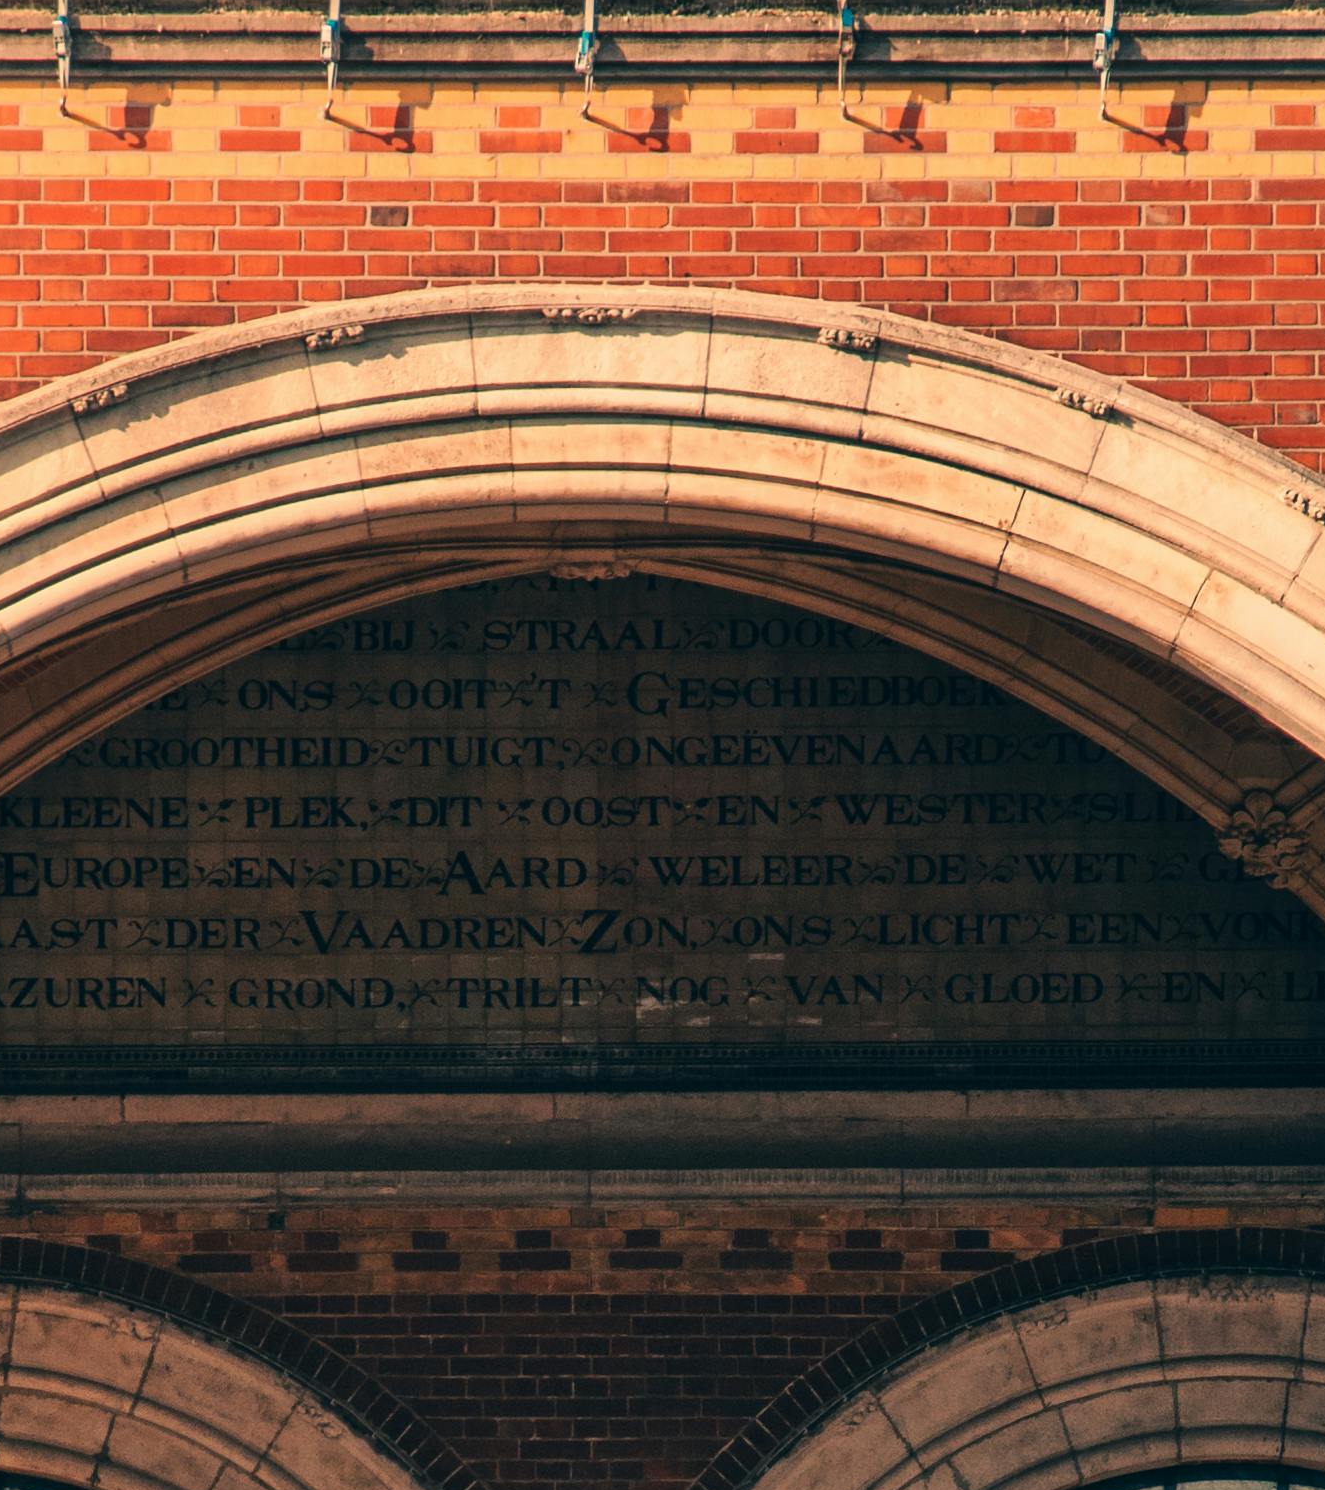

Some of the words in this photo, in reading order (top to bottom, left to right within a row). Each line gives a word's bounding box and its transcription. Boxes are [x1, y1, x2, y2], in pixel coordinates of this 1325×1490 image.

[354, 620, 414, 651] BIJ
[483, 620, 682, 651] STRAAL
[730, 618, 853, 651] DOOR
[238, 679, 336, 710] ONS
[388, 678, 496, 710] OOIT
[99, 737, 368, 769] GROOTHEID
[611, 729, 1010, 767] ONGEËVENAARD
[246, 797, 368, 832] PLEK,
[407, 796, 482, 828] DIT
[542, 796, 674, 829] OOST
[717, 795, 779, 827] EN
[836, 793, 1047, 827] WESTER
[0, 852, 188, 897] EUROPE
[234, 859, 295, 888] EN
[351, 858, 410, 887] DE
[440, 851, 587, 895] AARD
[650, 855, 852, 887] WELEER
[905, 854, 965, 885] DE
[1029, 853, 1136, 884] WET
[165, 918, 261, 950] DER
[297, 910, 547, 954] VAADREN
[732, 916, 831, 948] ONS
[878, 913, 1022, 947] LICHT
[1067, 912, 1163, 944] EEN
[228, 977, 405, 1011] GROND,
[446, 977, 592, 1008] TRILT
[638, 976, 730, 1007] NOG
[786, 974, 884, 1006] VAN
[945, 973, 1103, 1004] GLOED
[1163, 972, 1227, 1002] EN
